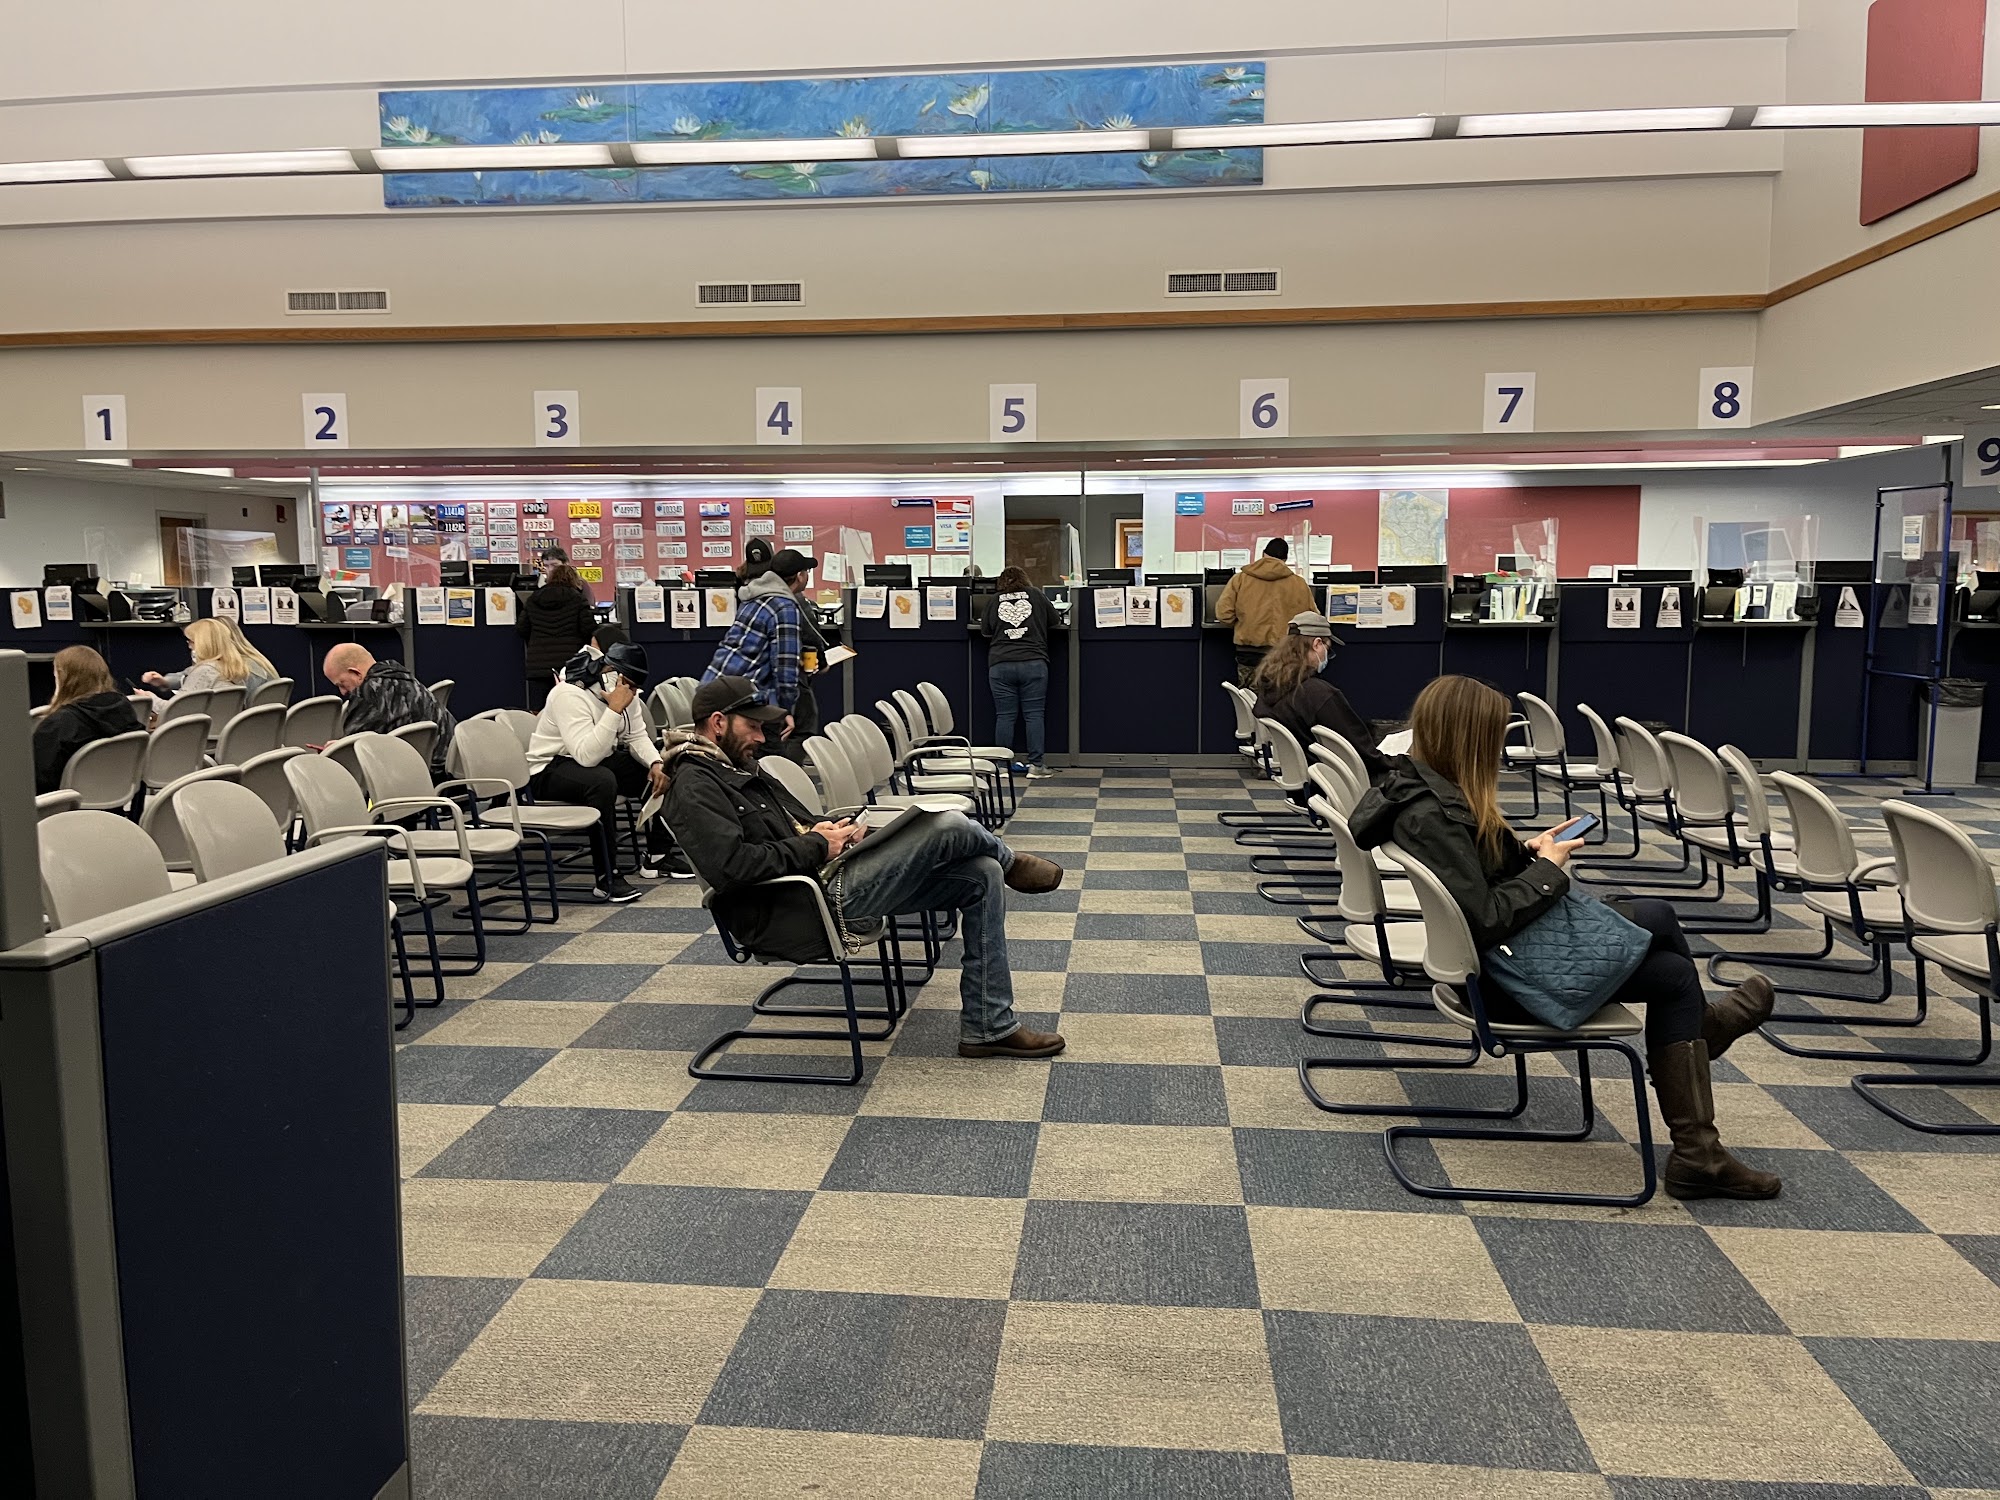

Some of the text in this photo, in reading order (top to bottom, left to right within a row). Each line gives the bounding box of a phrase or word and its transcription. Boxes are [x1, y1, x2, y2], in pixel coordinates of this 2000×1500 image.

[1002, 398, 1025, 433] 5
[1252, 393, 1278, 428] 6
[1499, 388, 1523, 422] 7
[1712, 382, 1739, 418] 8
[97, 409, 111, 440] 1
[315, 407, 337, 439] 2
[547, 404, 568, 438] 3
[767, 402, 792, 435] 4
[1978, 438, 2000, 475] 9
